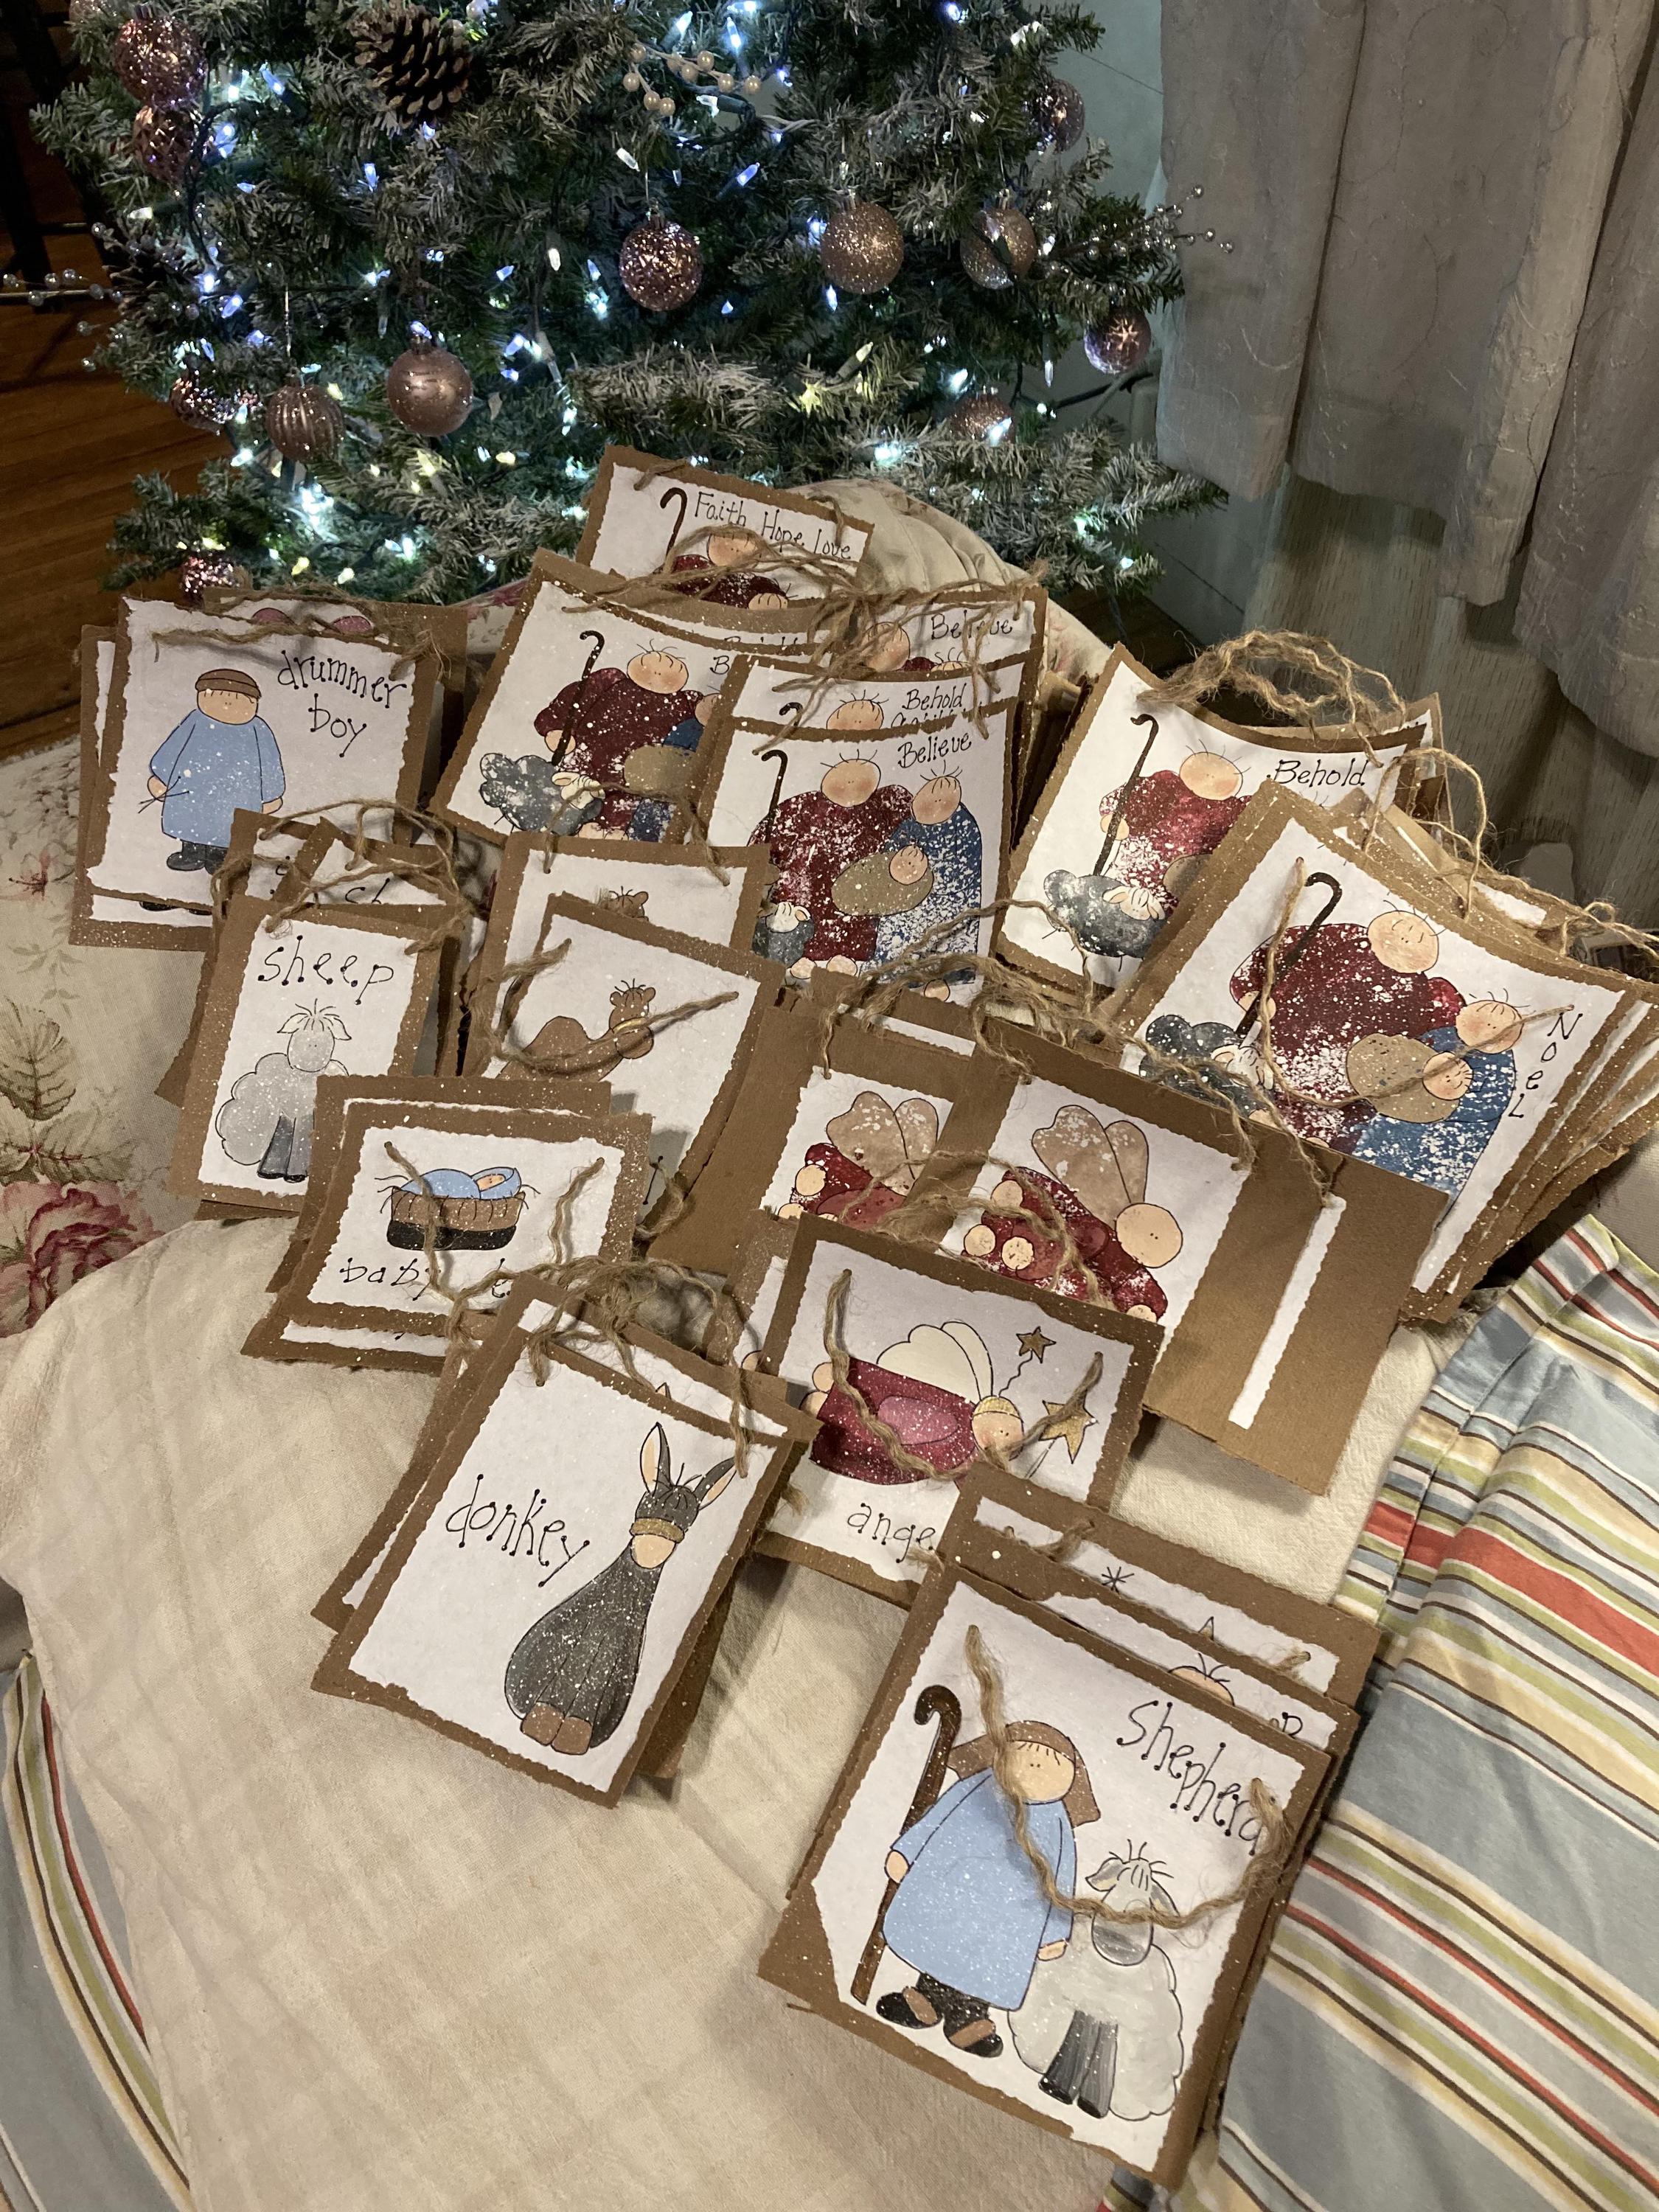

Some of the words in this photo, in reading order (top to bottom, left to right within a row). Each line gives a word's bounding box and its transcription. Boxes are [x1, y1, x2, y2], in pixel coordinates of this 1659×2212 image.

[695, 491, 746, 526] Faith
[761, 509, 804, 552] Hope
[277, 650, 407, 709] drummer
[902, 683, 967, 711] Behold
[308, 693, 367, 758] boy
[897, 732, 972, 769] Believe
[1266, 758, 1369, 787] Behold
[445, 1473, 590, 1587] donkey
[847, 1503, 936, 1564] ange
